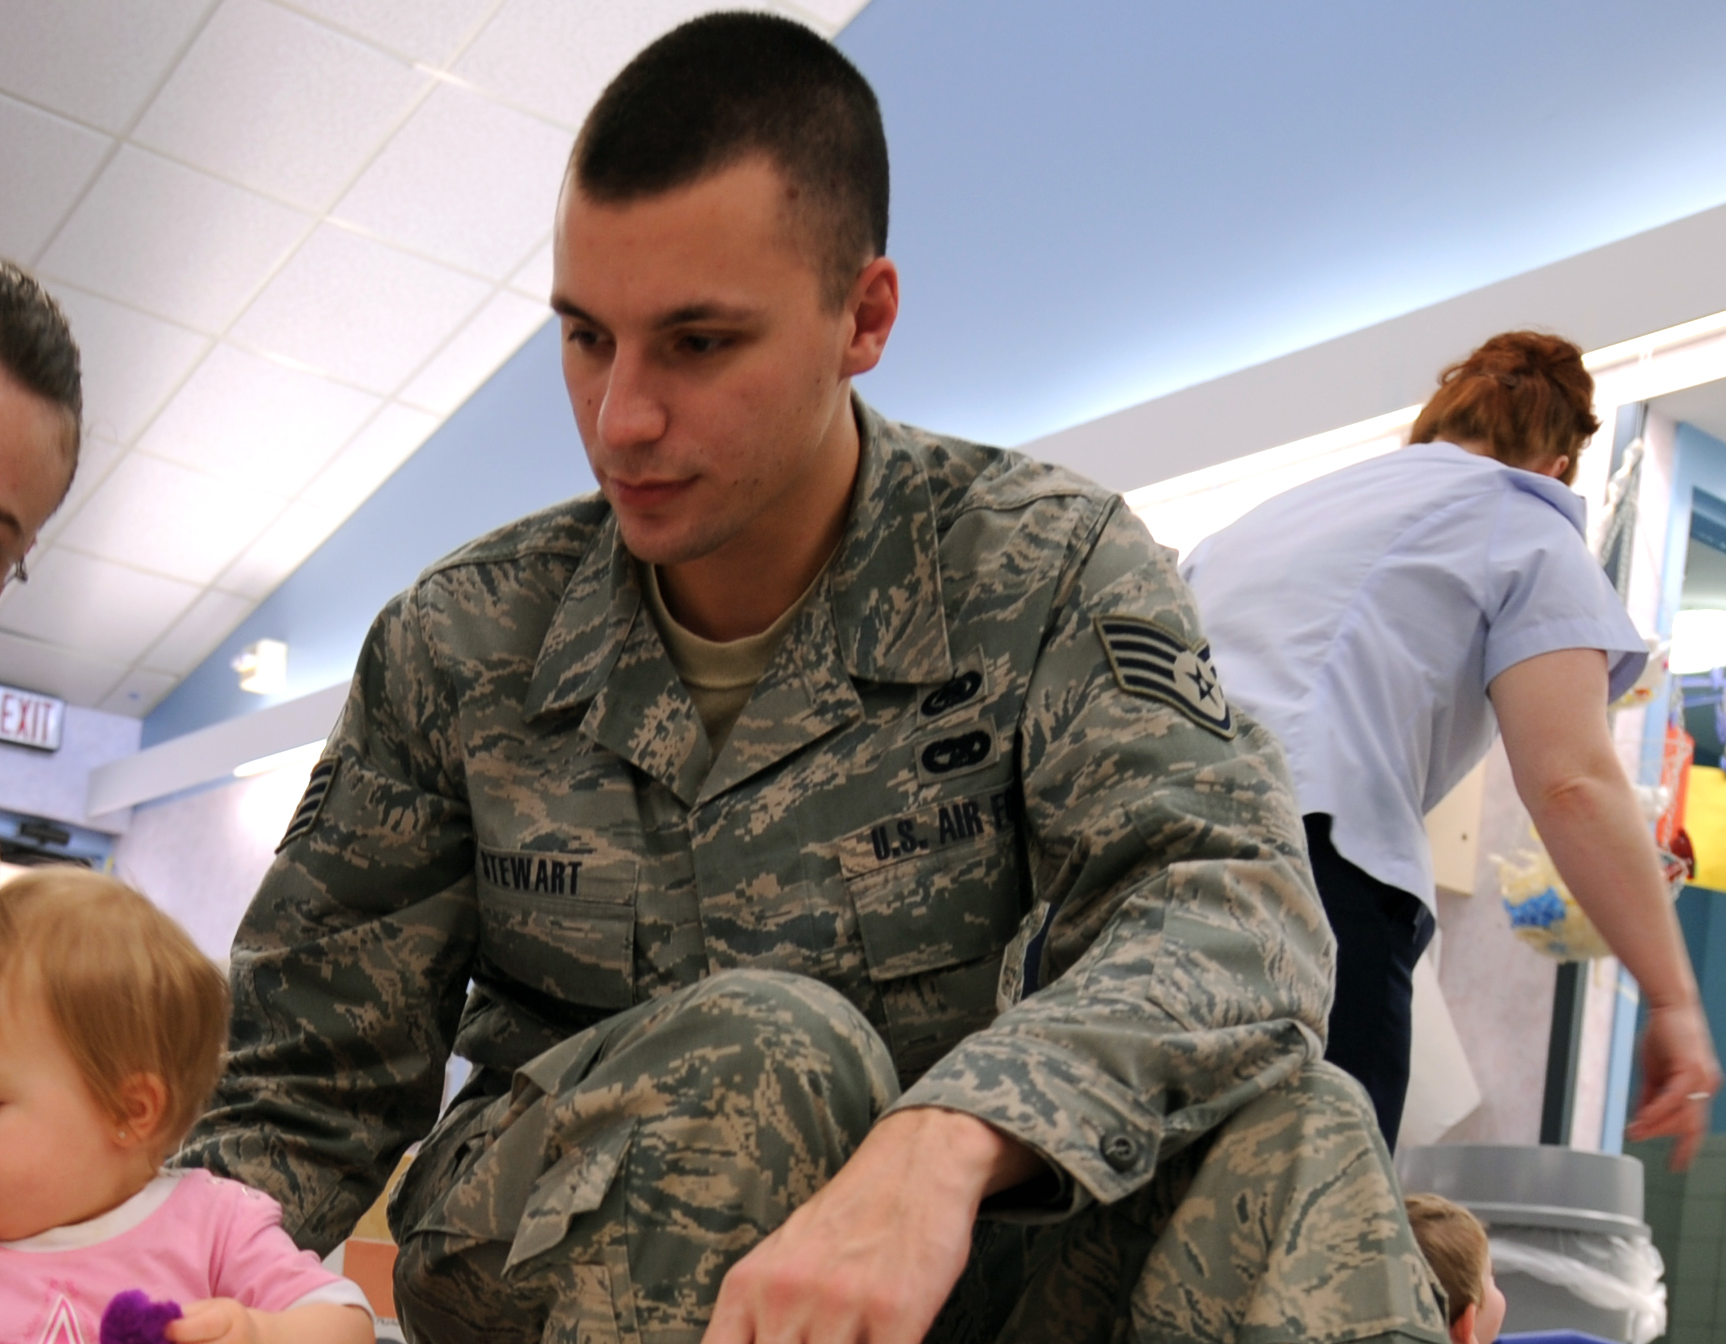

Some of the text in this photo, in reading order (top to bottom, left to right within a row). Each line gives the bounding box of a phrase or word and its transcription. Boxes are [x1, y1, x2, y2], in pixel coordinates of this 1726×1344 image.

[0, 693, 53, 743] EXIT
[871, 822, 929, 861] U.S.
[938, 801, 984, 845] AIR
